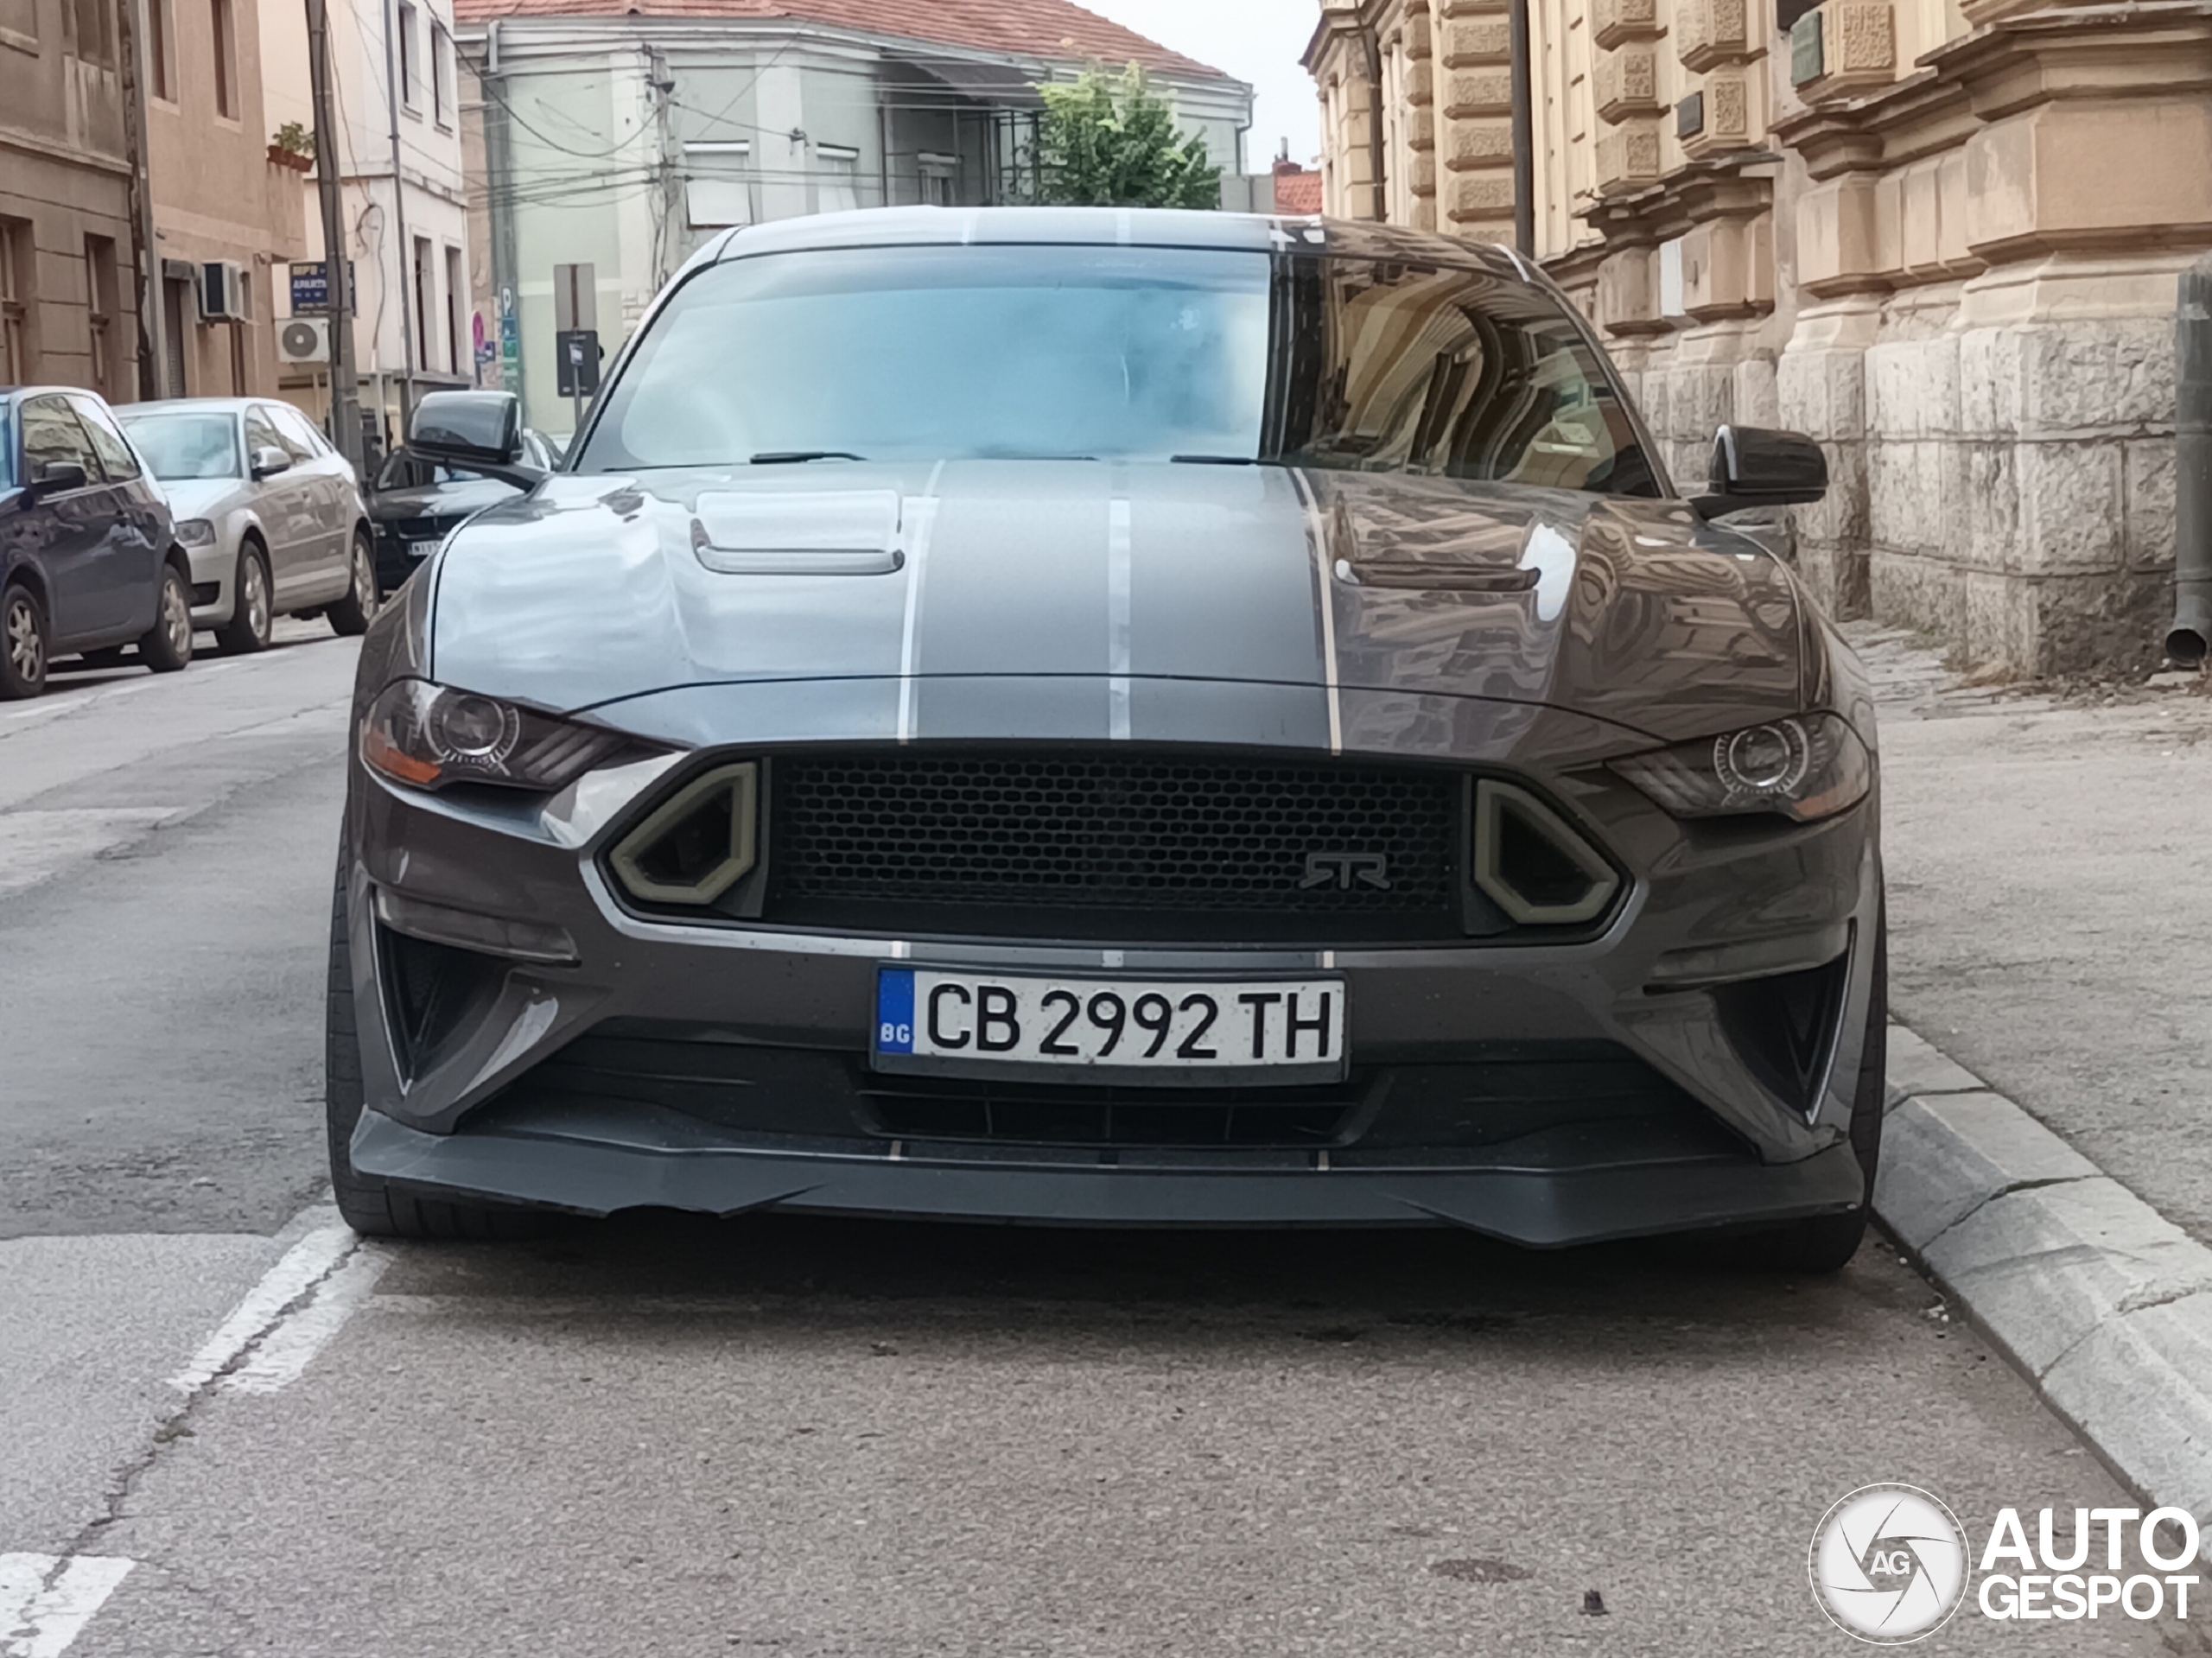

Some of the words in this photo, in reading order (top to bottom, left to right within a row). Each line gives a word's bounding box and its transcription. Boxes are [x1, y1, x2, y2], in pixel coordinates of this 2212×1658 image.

[1299, 852, 1391, 889] RTR
[880, 1024, 911, 1044] BG
[927, 982, 1020, 1051] CB
[1039, 989, 1219, 1059] 2992
[1237, 991, 1331, 1059] TH
